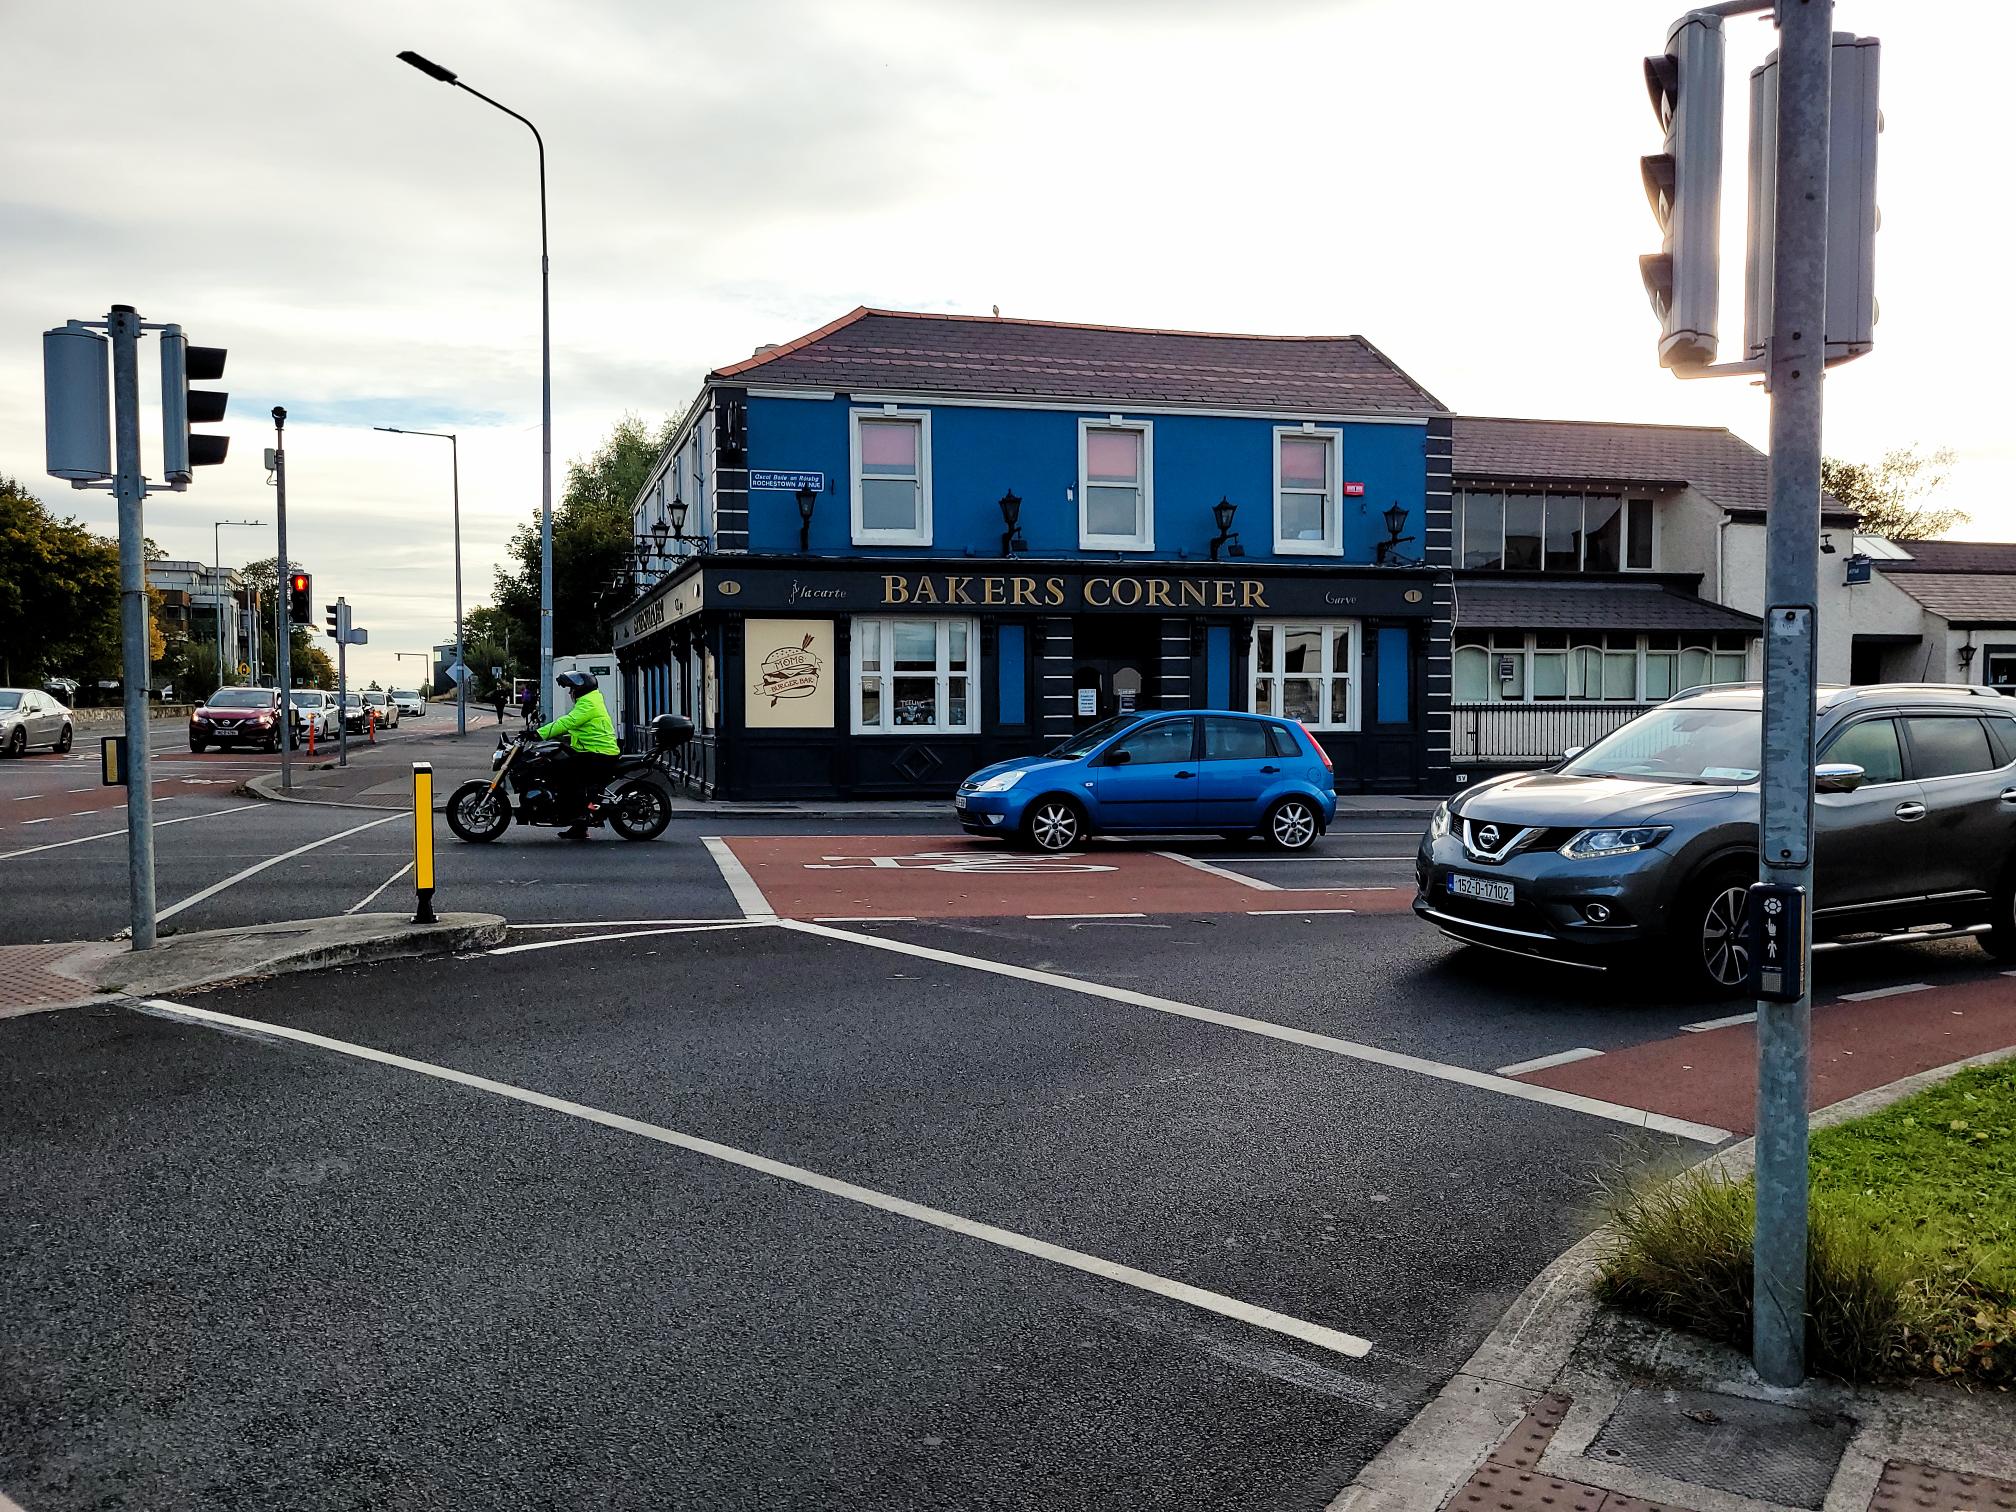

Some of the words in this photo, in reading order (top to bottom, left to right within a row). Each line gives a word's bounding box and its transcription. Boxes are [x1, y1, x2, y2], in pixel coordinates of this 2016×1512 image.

[752, 480, 796, 488] ROCHESTOWN
[880, 575, 1065, 605] BAKERS
[1083, 577, 1270, 608] CORNER
[1457, 878, 1509, 900] 152-D-17102
